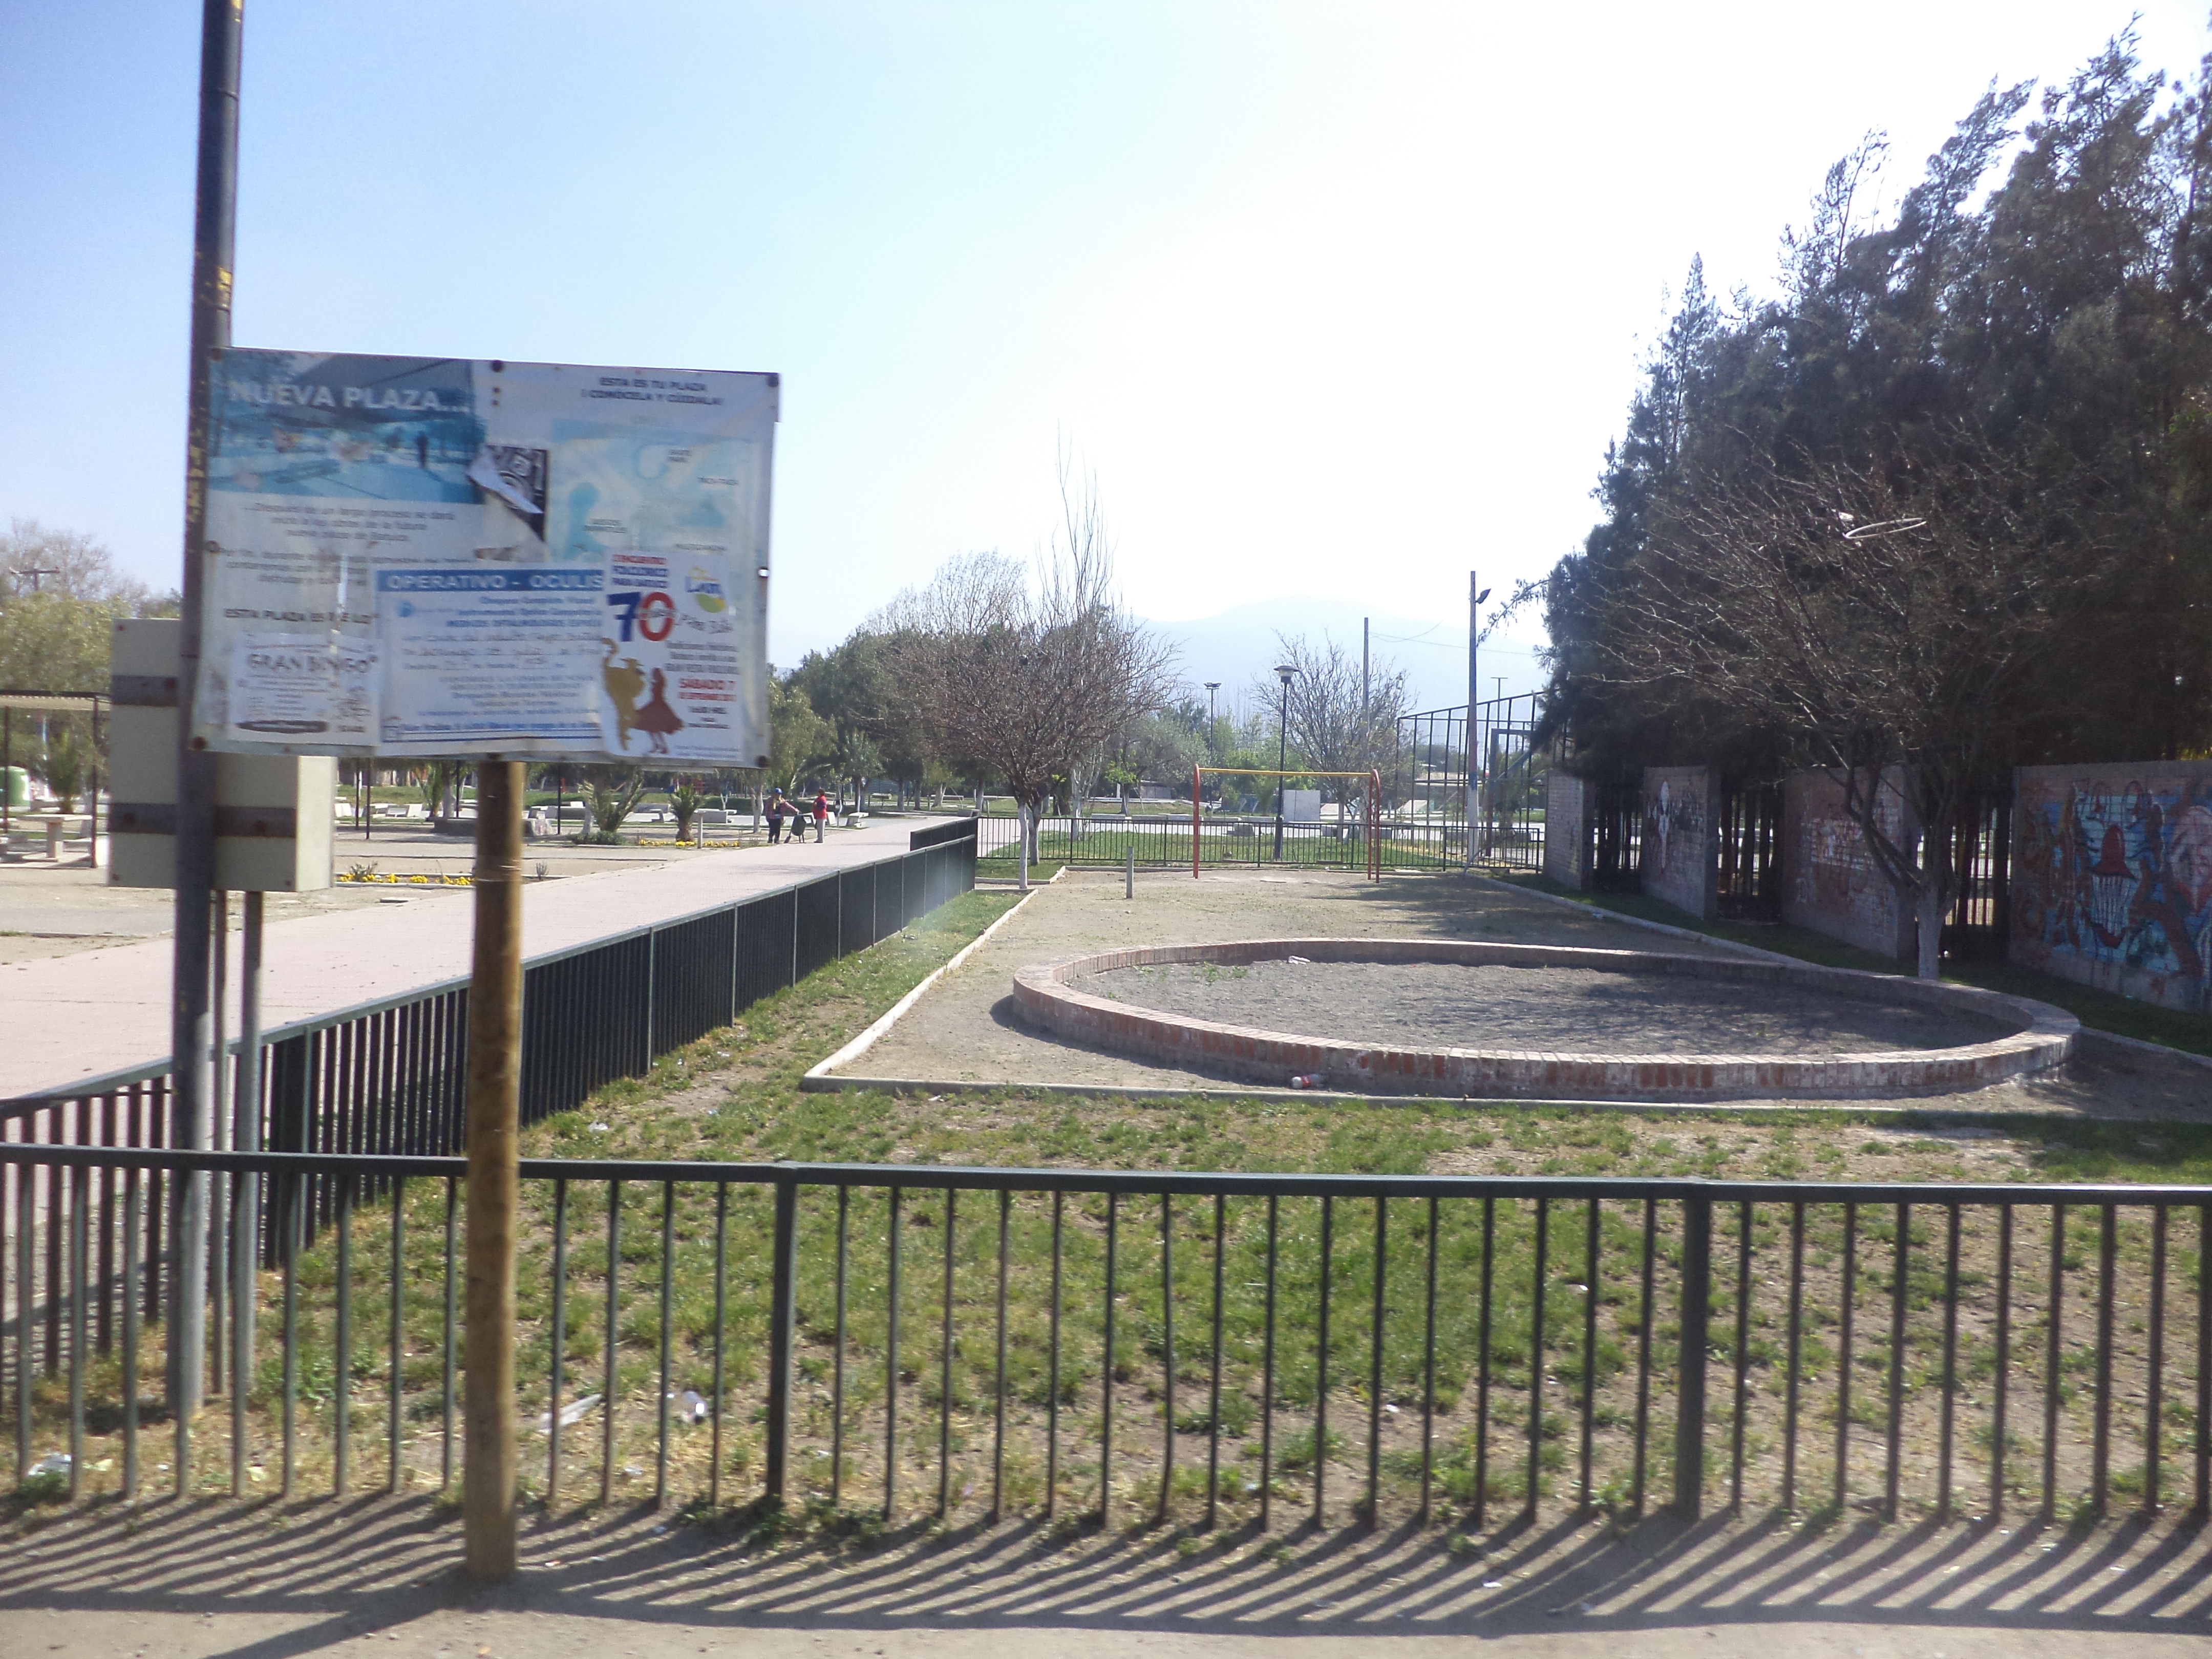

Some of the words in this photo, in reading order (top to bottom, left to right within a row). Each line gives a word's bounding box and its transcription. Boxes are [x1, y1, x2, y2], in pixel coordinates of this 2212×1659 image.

[600, 377, 628, 386] ESTA
[632, 379, 648, 388] ES
[668, 381, 707, 392] PLAZA
[228, 380, 336, 408] NUEVA
[387, 575, 506, 589] OPERATIVO
